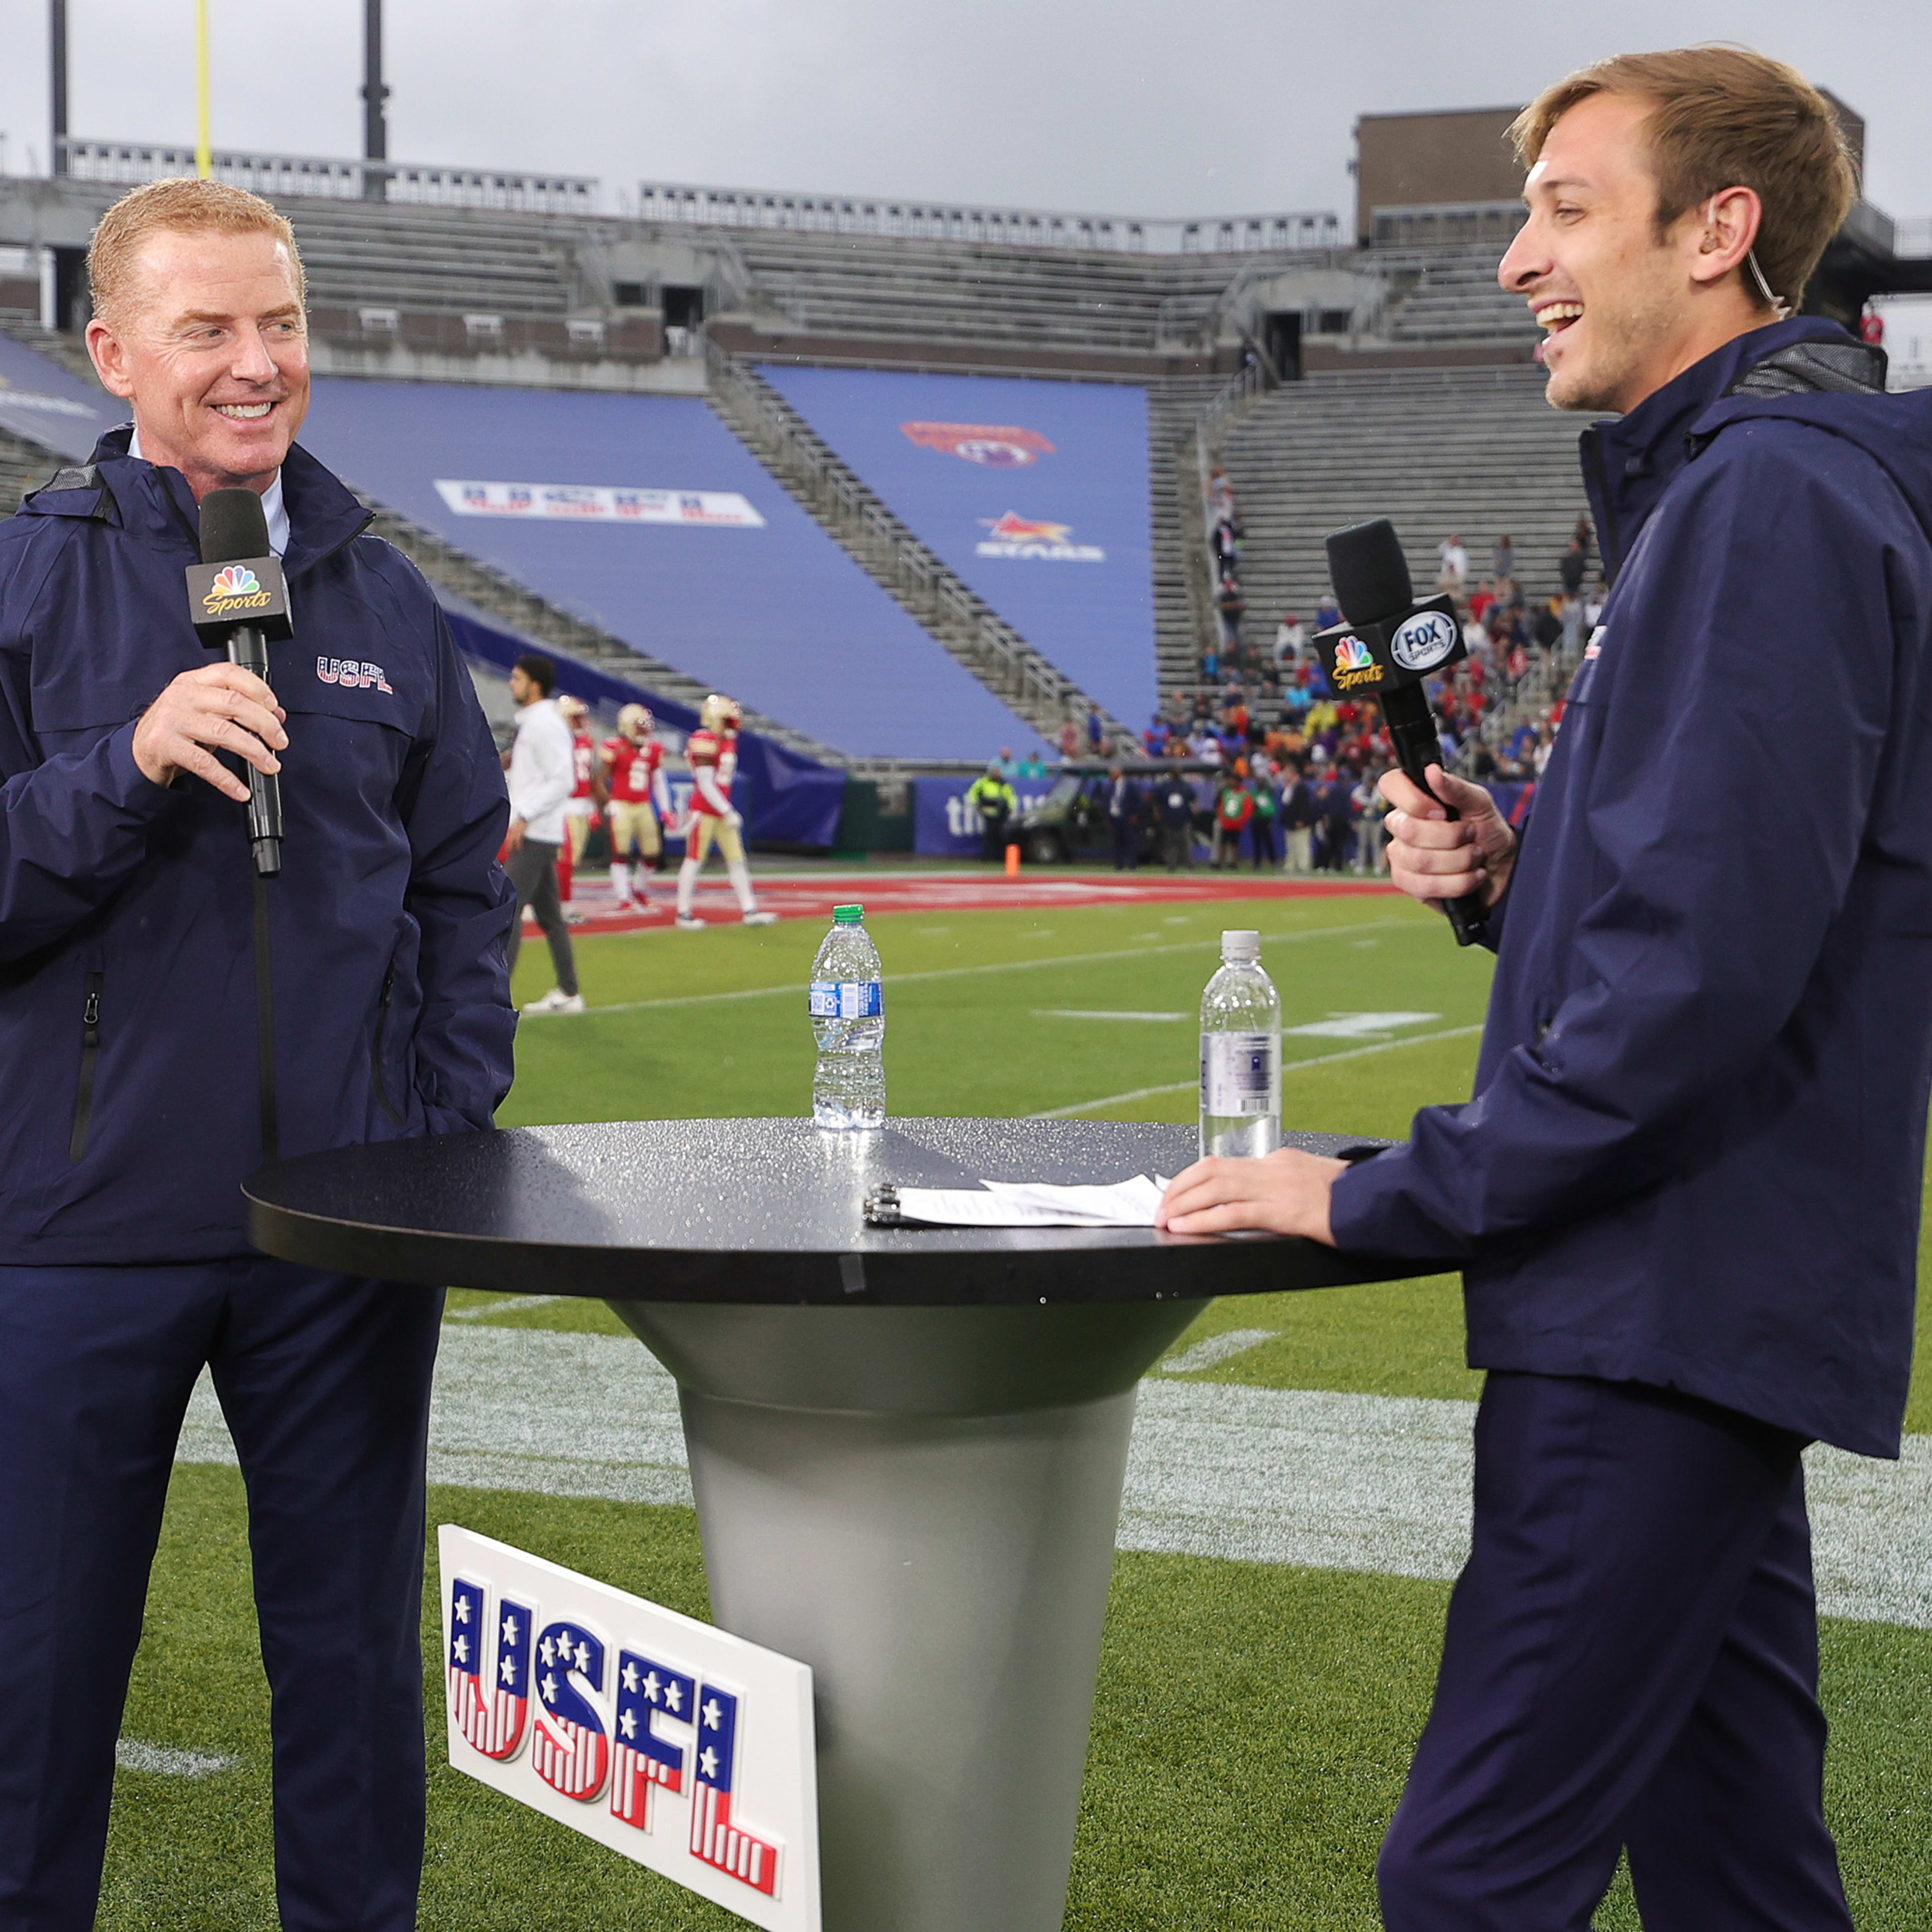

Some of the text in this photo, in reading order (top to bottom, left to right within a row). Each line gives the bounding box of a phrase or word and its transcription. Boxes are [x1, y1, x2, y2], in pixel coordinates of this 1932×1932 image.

[462, 484, 742, 523] USFL
[203, 591, 271, 616] Sports
[1403, 620, 1440, 652] FOX
[1410, 640, 1446, 661] SPORTS
[317, 657, 393, 695] USFL
[1332, 664, 1384, 691] Sports
[450, 1577, 778, 1897] USFL
